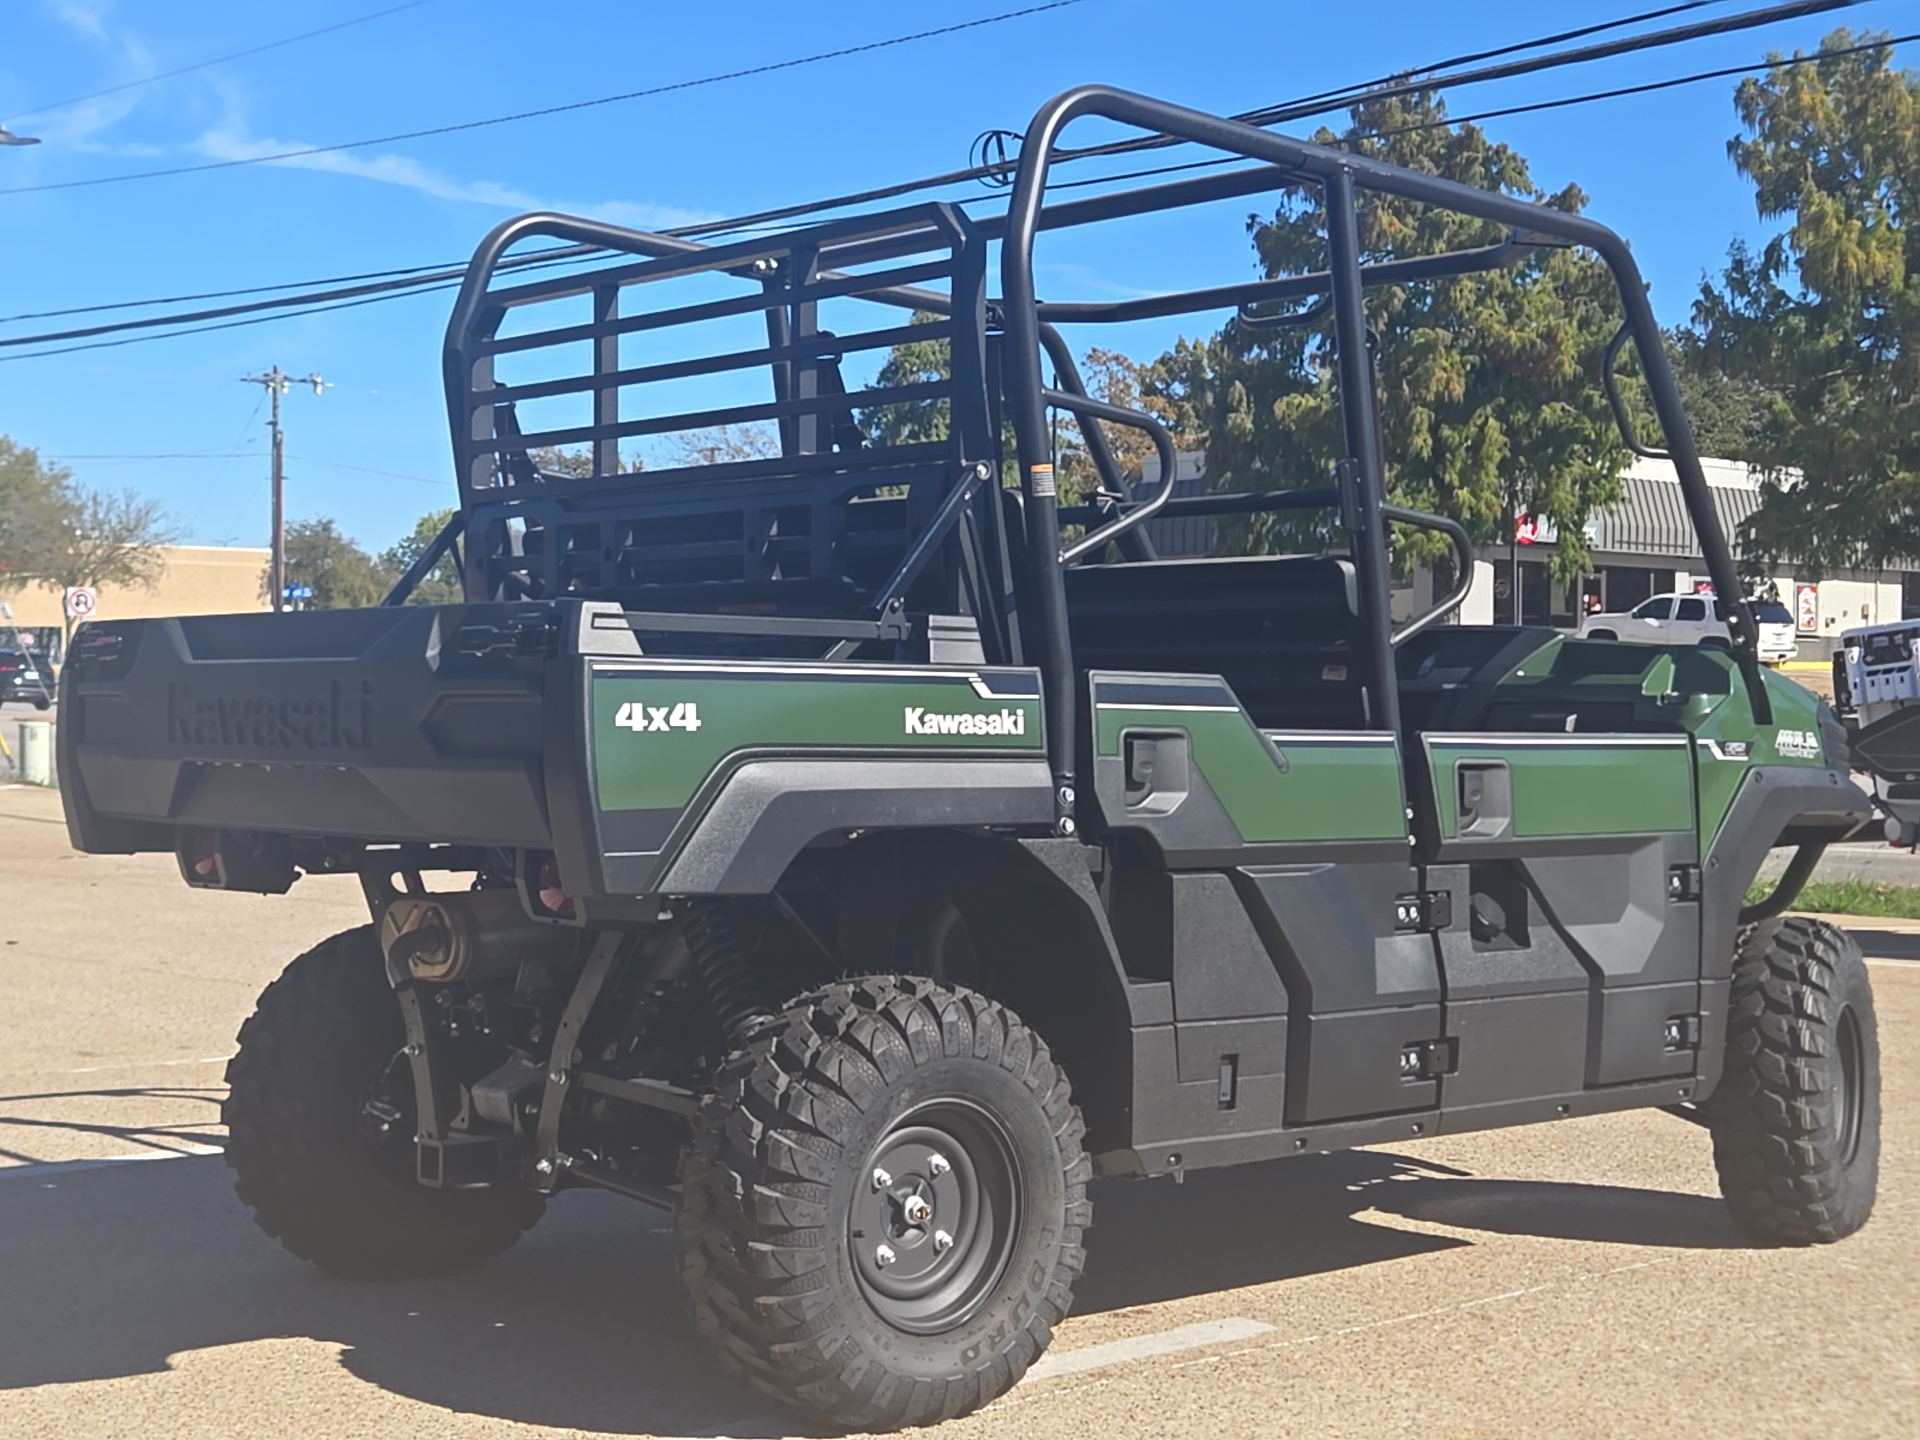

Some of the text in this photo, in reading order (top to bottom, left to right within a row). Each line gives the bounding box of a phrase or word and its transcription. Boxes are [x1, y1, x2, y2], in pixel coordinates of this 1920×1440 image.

[167, 679, 374, 749] Kawasaki
[615, 702, 702, 732] 4x4
[904, 707, 1025, 735] Kawasaki
